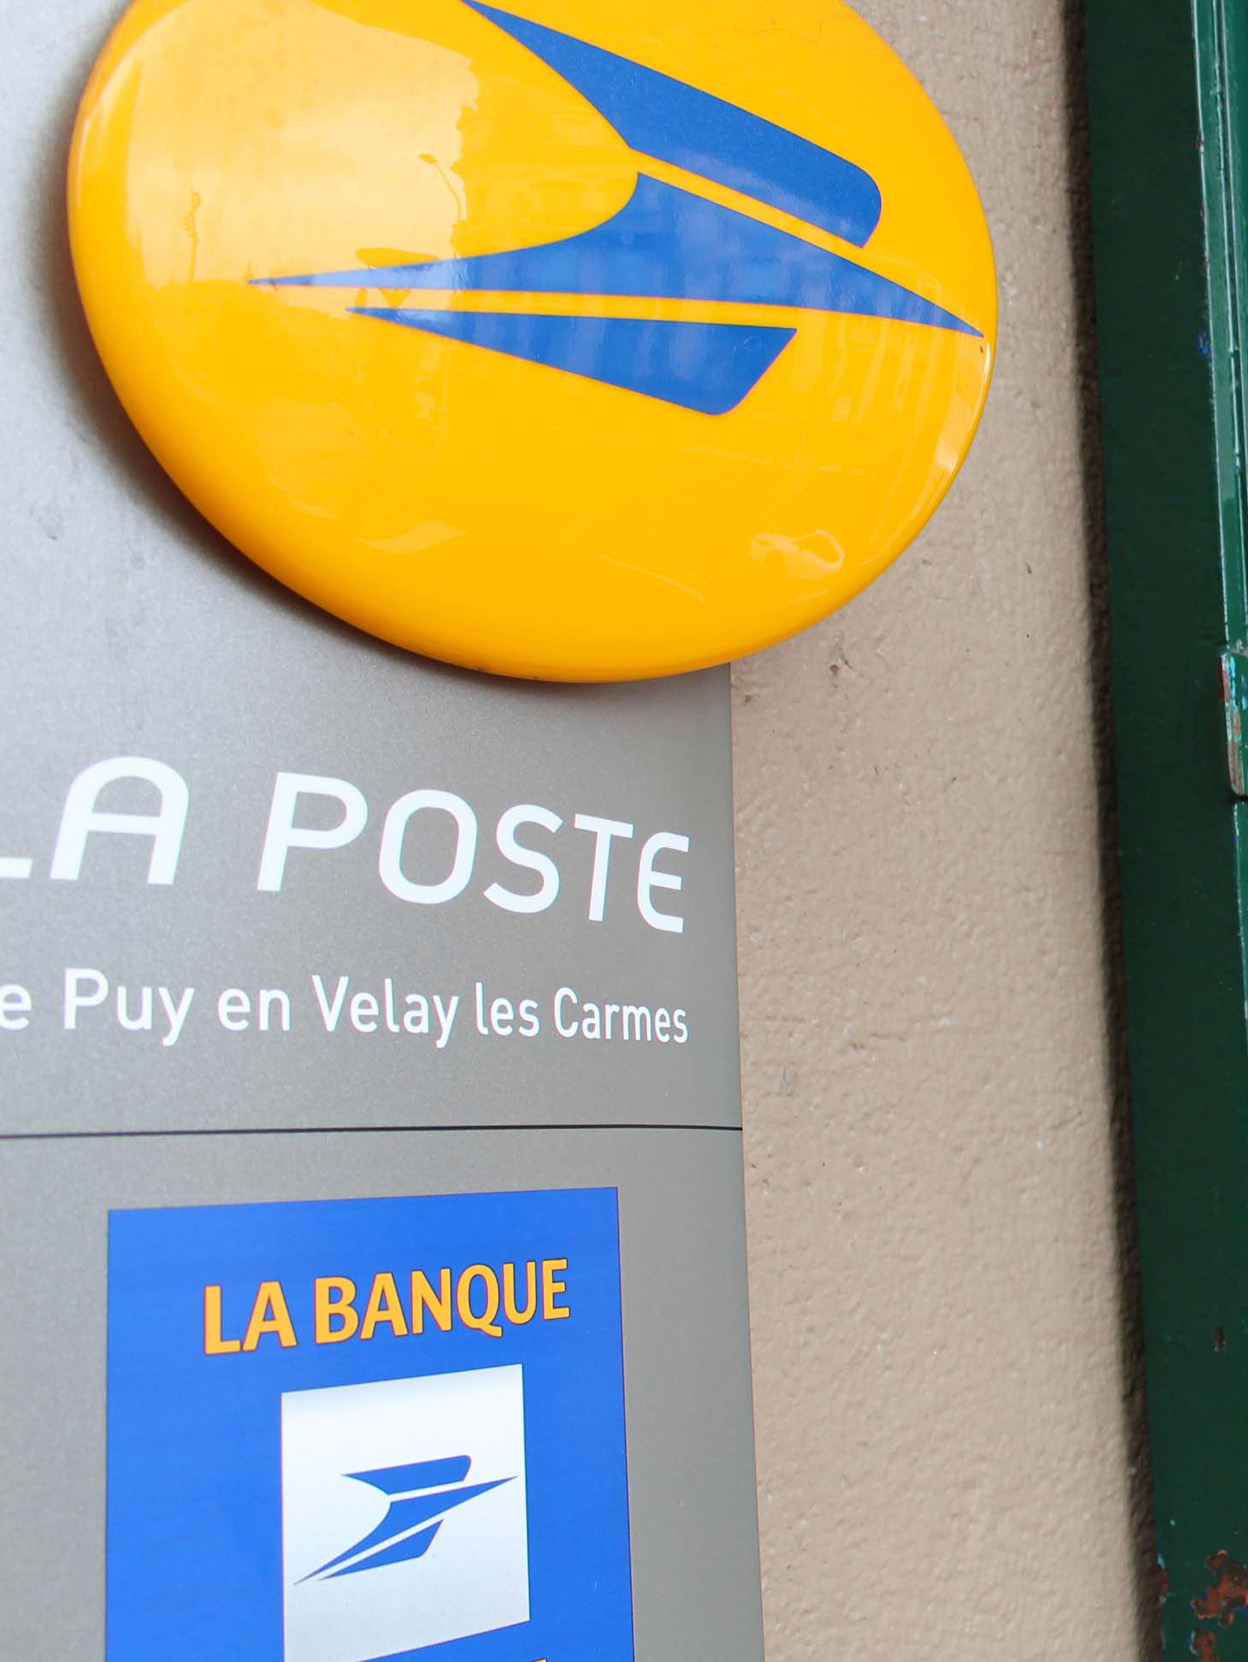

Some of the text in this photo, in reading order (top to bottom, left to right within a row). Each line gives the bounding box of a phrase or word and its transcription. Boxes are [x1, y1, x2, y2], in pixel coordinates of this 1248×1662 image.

[256, 771, 690, 934] POSTE
[63, 967, 195, 1047] Puy
[217, 988, 290, 1032] en
[311, 974, 459, 1049] Velay
[475, 982, 540, 1037] les
[554, 986, 689, 1044] Carmes
[203, 1257, 572, 1355] LA BANQUE
